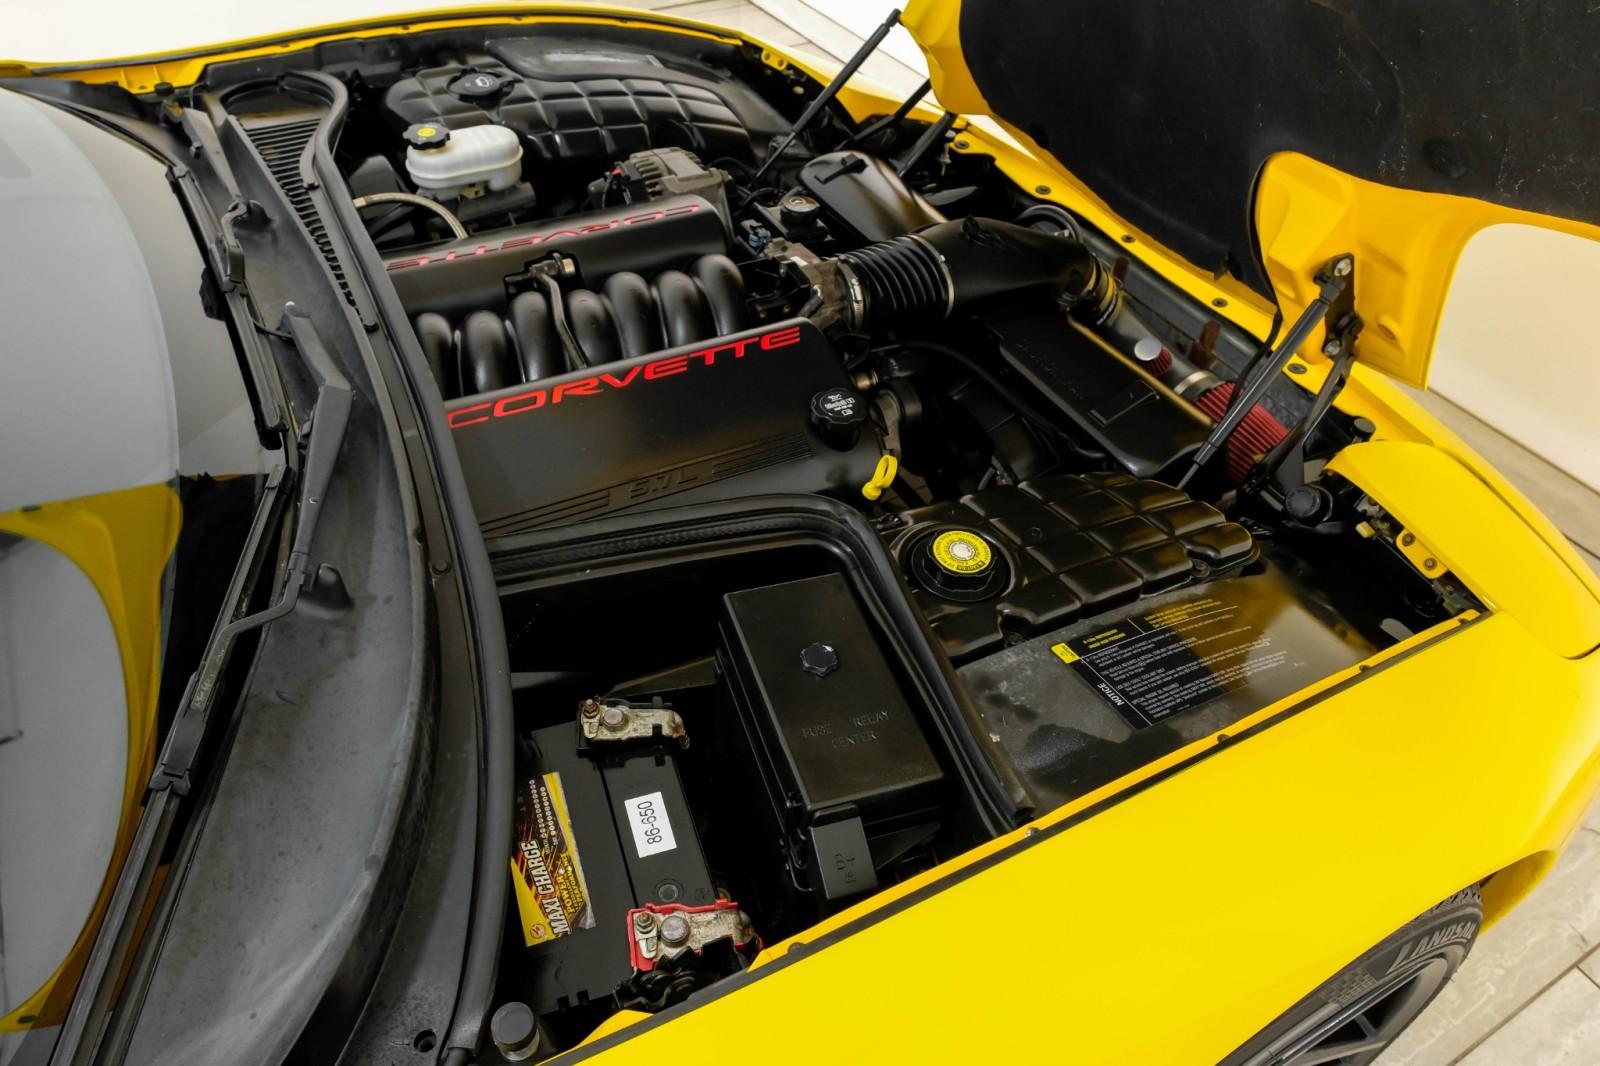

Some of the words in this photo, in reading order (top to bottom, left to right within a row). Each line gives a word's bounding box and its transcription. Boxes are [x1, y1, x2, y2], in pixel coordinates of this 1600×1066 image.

[386, 204, 701, 271] CORVETTE
[447, 326, 801, 429] CORVETTE
[629, 469, 698, 499] 5.7L
[1096, 682, 1125, 706] NOTICE
[802, 723, 833, 739] FUSE
[852, 709, 890, 728] RELAY
[831, 730, 878, 749] CENTER
[637, 801, 663, 845] 86-650
[520, 840, 555, 896] CHARGE
[556, 875, 576, 914] POWER
[541, 896, 571, 935] MAXI
